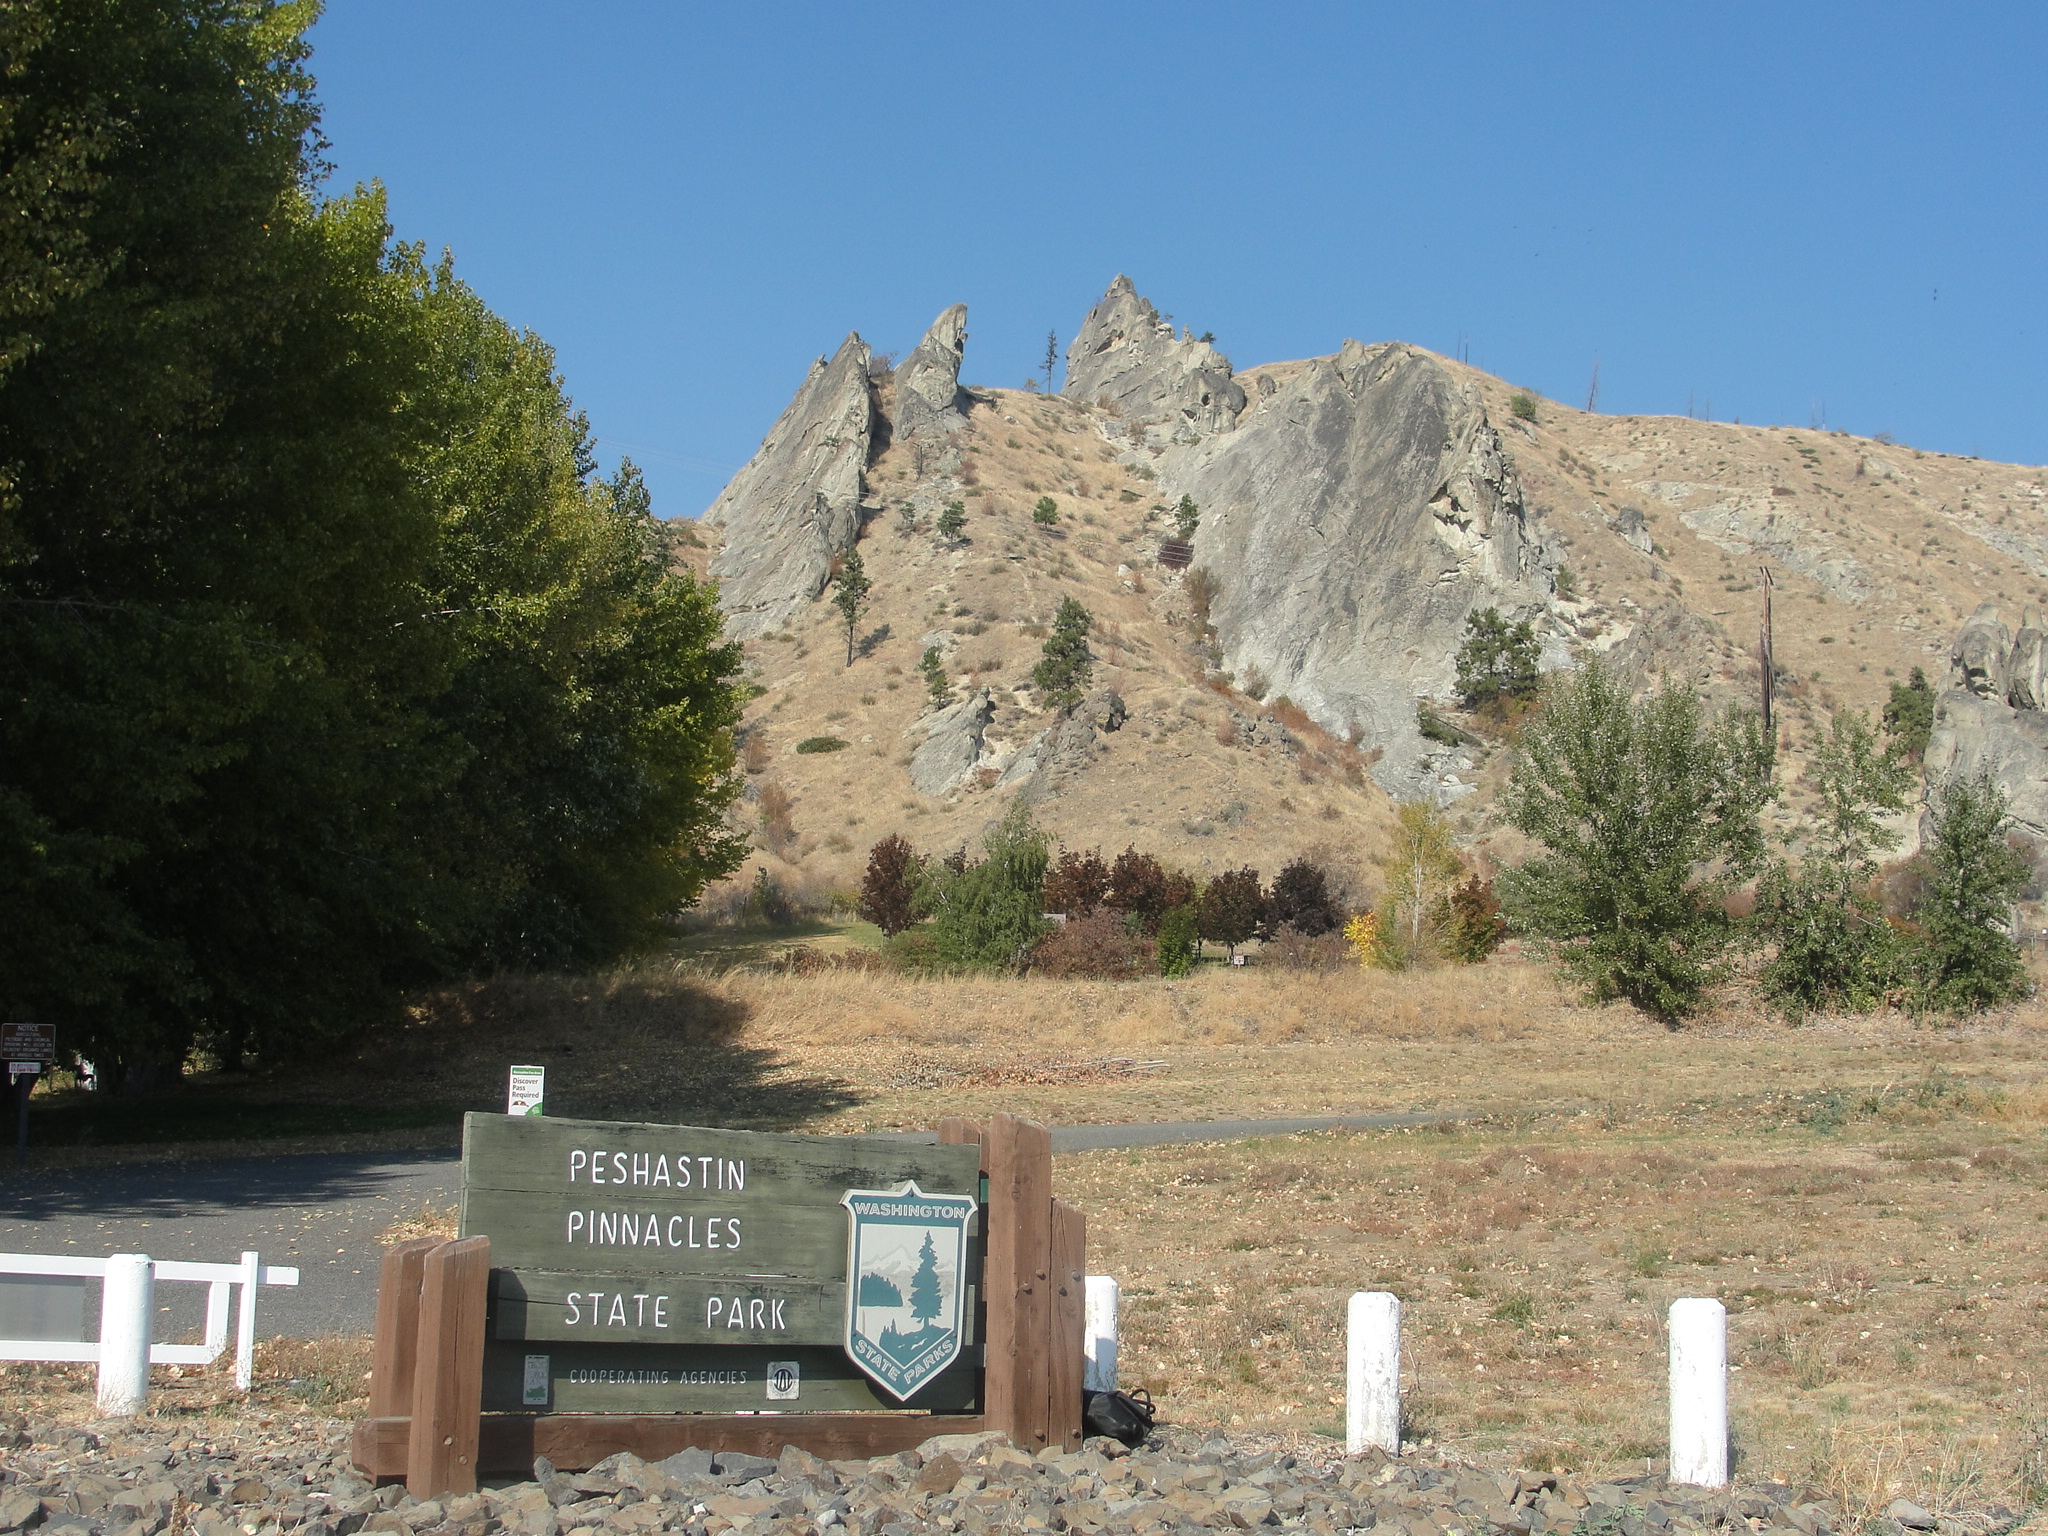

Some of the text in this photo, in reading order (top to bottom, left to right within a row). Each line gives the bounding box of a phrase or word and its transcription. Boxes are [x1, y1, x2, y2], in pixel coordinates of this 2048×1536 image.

[511, 1091, 540, 1099] Required
[512, 1077, 539, 1085] Discover
[570, 1149, 746, 1191] PESHASTIN
[854, 1202, 965, 1219] WASHINGTON
[567, 1209, 742, 1250] PINNACLES
[564, 1291, 786, 1331] STATE PARK
[855, 1339, 955, 1385] STATE PARKS
[569, 1368, 748, 1385] COOPERATING AGENCIES
